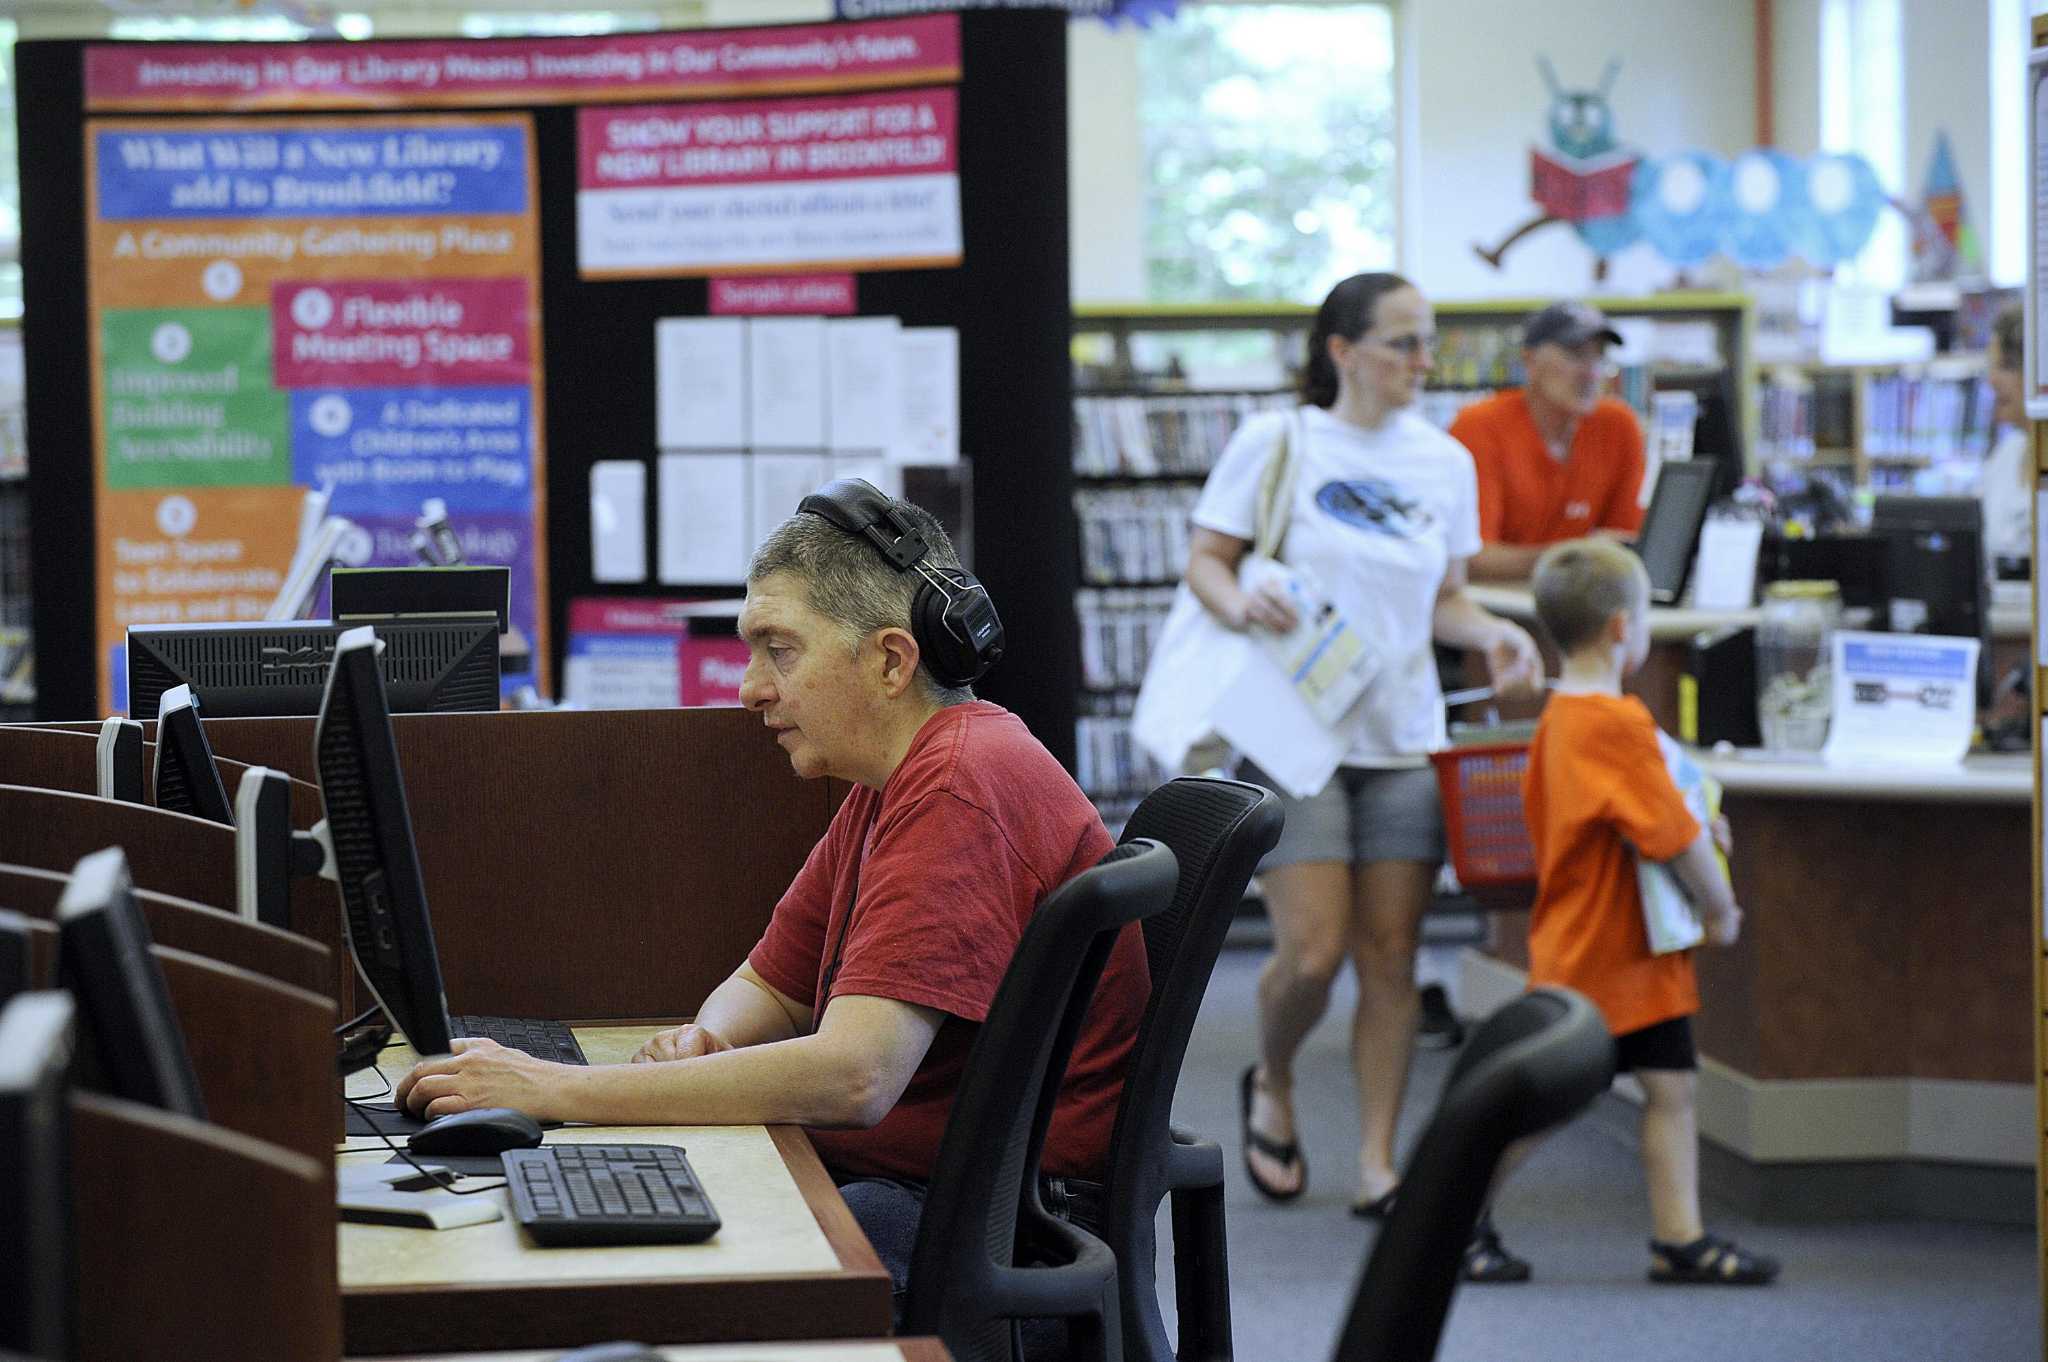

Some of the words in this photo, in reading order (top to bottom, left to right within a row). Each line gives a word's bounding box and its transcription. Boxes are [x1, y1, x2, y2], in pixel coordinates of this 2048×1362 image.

[138, 60, 257, 90] Investing
[264, 59, 290, 83] in
[292, 57, 342, 85] Our
[349, 55, 439, 88] Library
[445, 53, 529, 80] Means
[533, 51, 643, 81] Investing
[649, 50, 668, 74] in
[671, 45, 718, 73] Our
[607, 117, 690, 149] SHOW
[692, 112, 765, 145] YOUR
[767, 107, 870, 142] SUPPORT
[872, 103, 915, 134] FOR
[917, 101, 937, 130] A
[121, 138, 205, 170] What
[208, 136, 280, 170] Will
[309, 137, 374, 168] New
[383, 133, 505, 172] Library
[596, 149, 661, 181] NEW
[663, 143, 770, 178] LIBRARY
[775, 144, 802, 172] IN
[171, 173, 232, 208] add
[234, 177, 269, 206] to
[272, 171, 456, 207] Brookfield?
[114, 230, 139, 258] A
[141, 227, 294, 262] Community
[301, 225, 436, 262] Gathering
[441, 223, 513, 254] Place
[343, 295, 463, 329] Flexible
[293, 332, 420, 368] Meeting
[424, 330, 514, 366] Space
